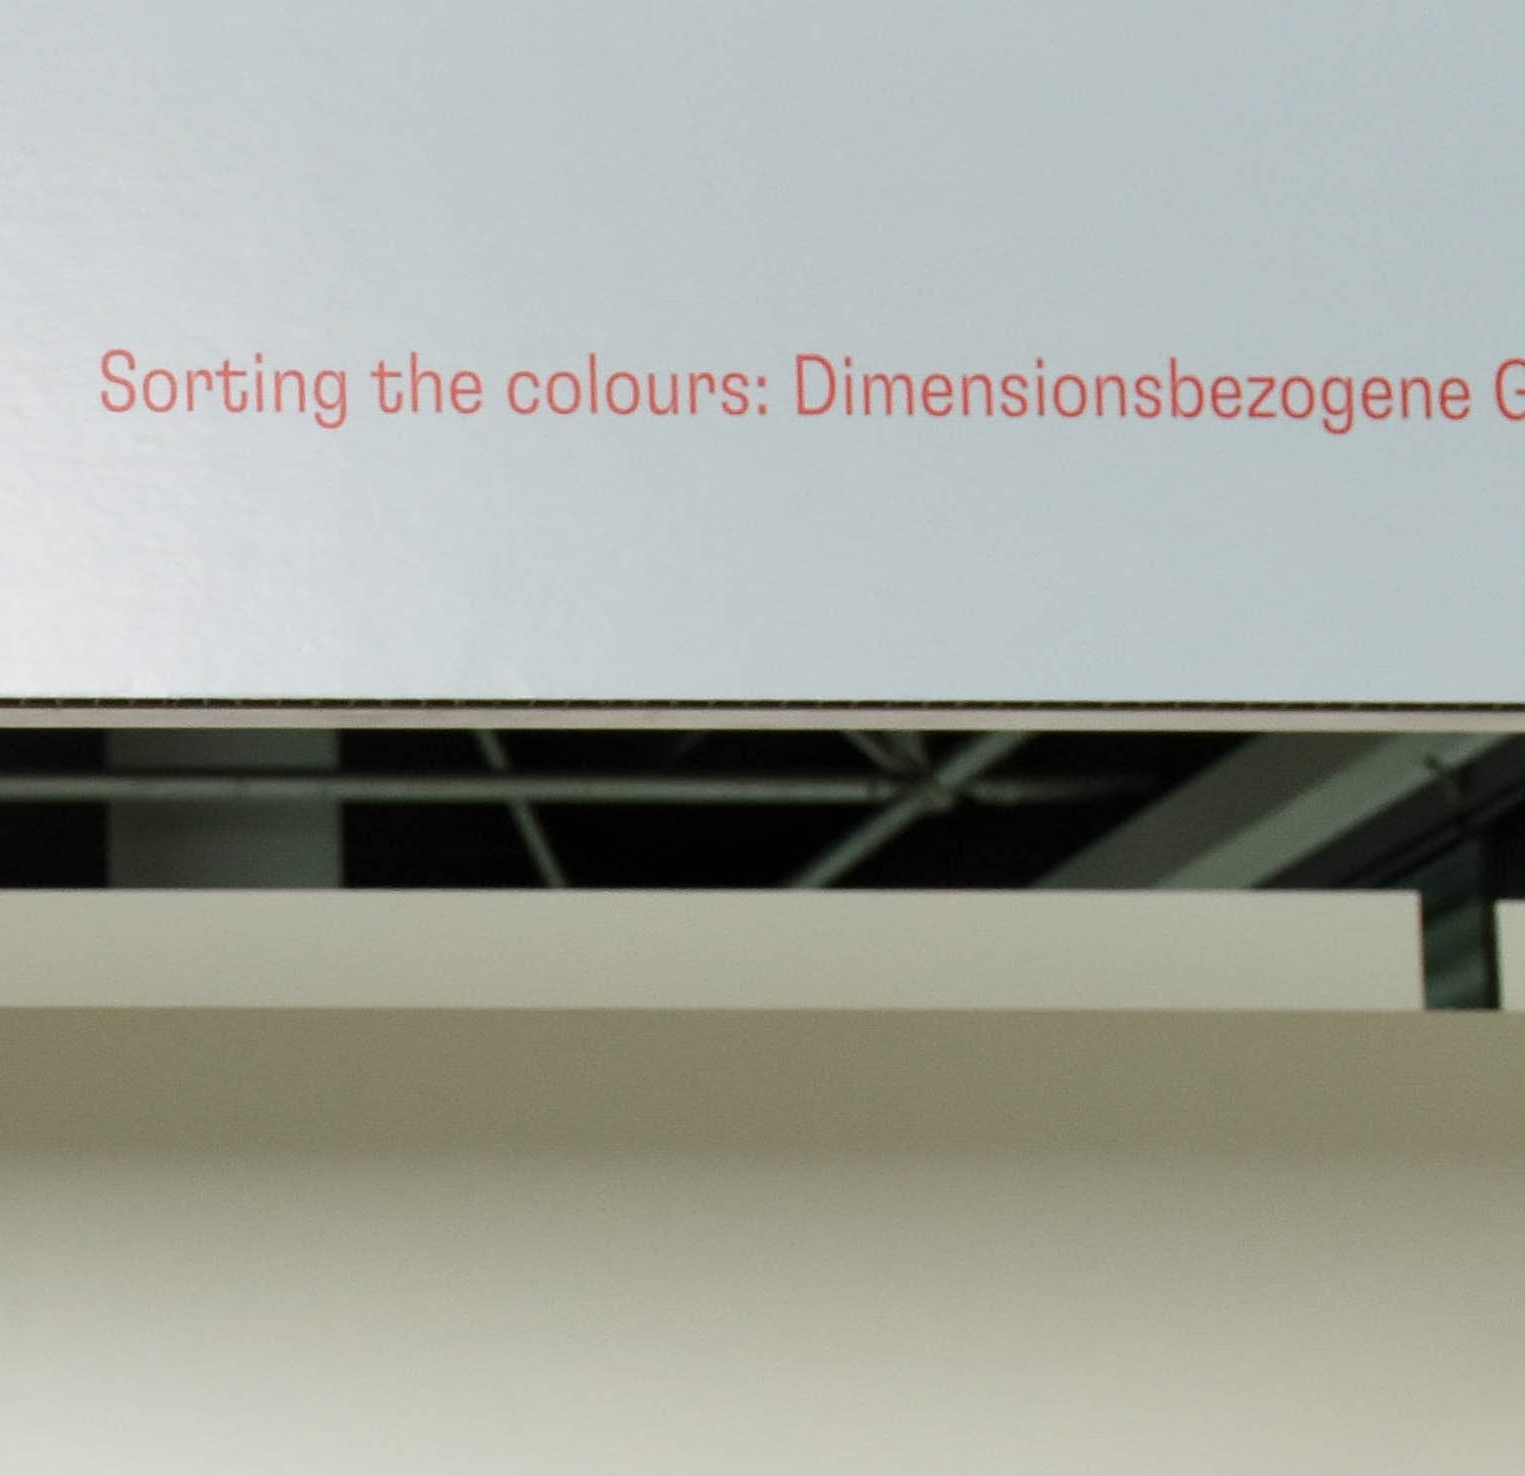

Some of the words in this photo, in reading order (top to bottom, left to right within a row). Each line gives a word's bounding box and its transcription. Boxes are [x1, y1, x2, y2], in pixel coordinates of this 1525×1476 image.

[99, 347, 349, 430] Sorting
[371, 352, 484, 416] the
[505, 351, 769, 417] colours:
[795, 352, 1473, 436] Dimensionsbezogene
